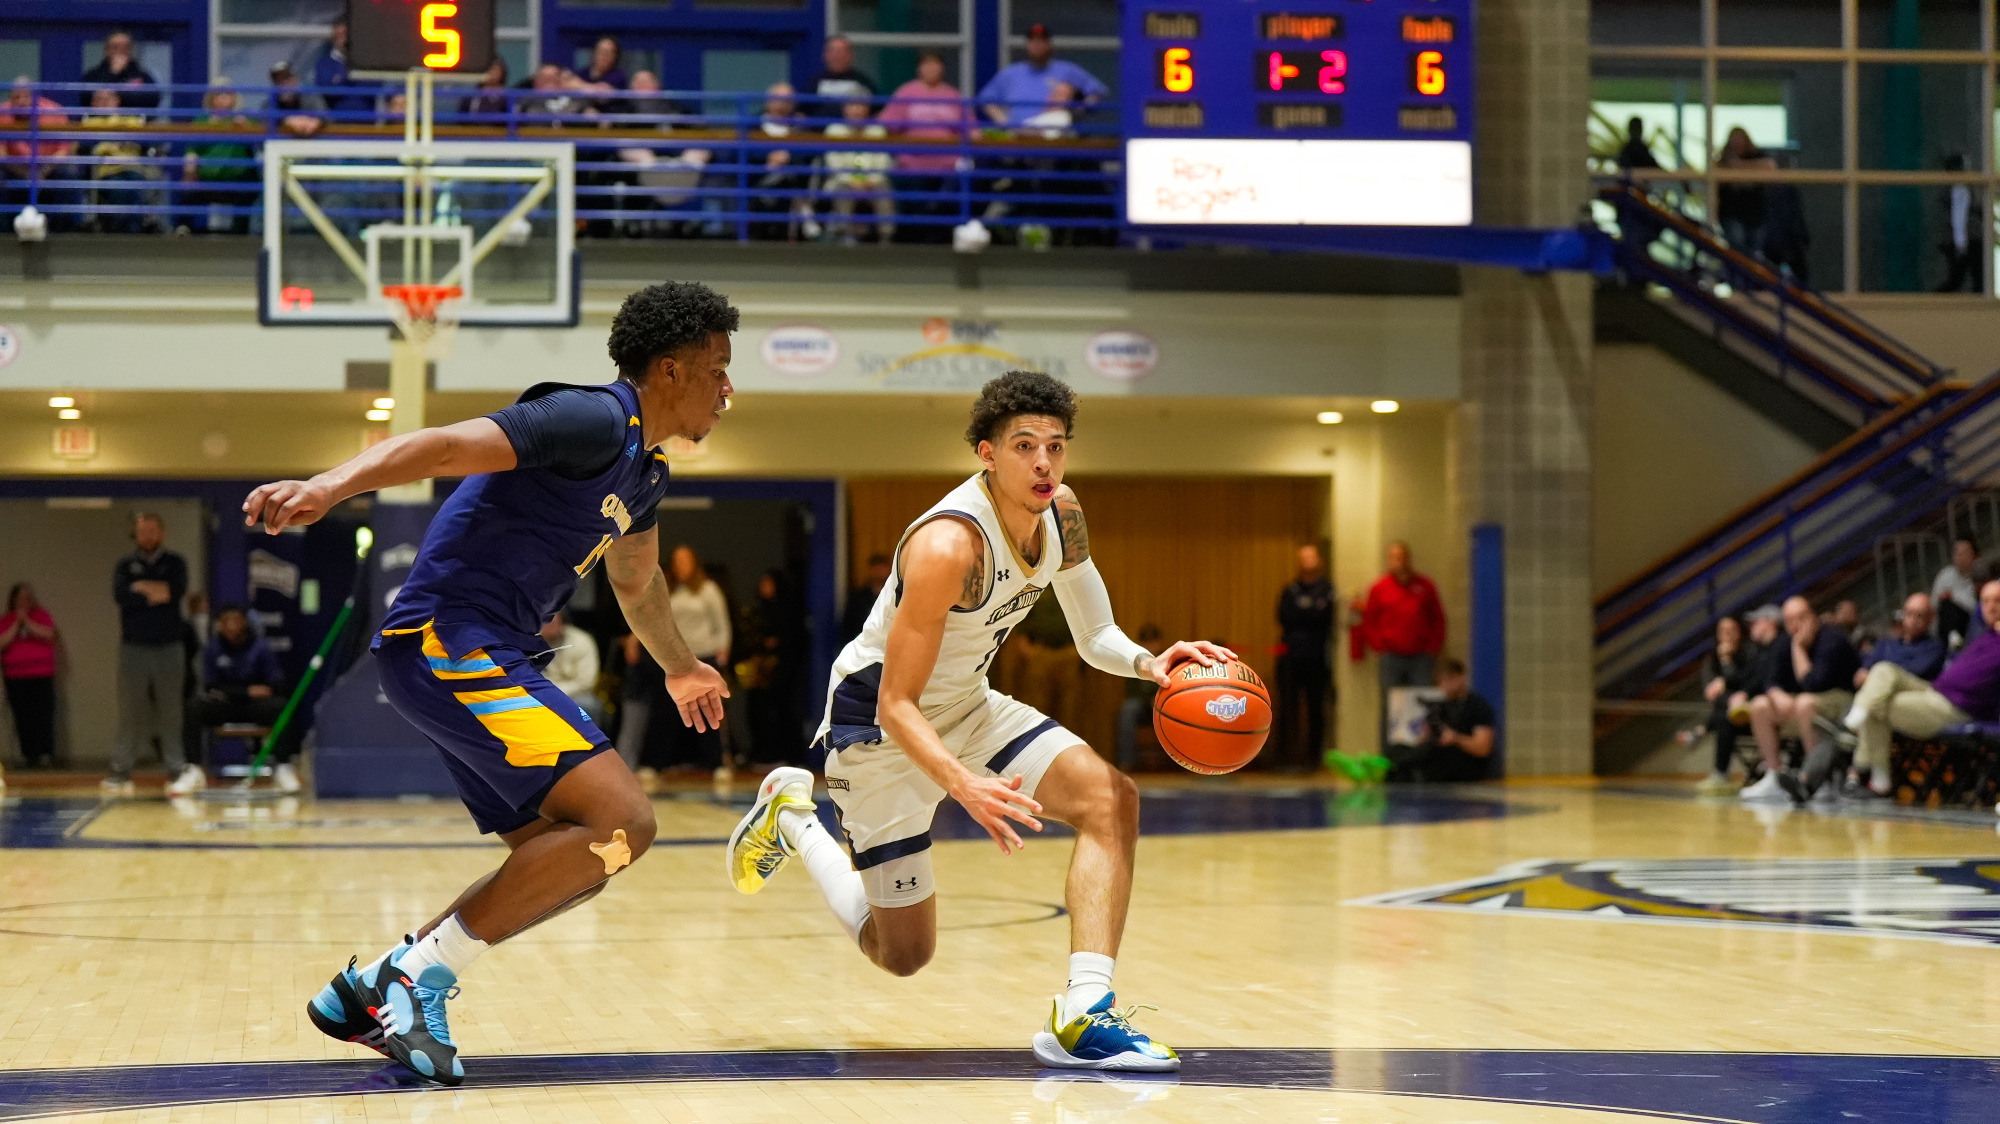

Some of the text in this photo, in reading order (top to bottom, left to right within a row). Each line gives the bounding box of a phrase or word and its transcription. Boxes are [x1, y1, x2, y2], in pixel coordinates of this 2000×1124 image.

[421, 4, 460, 68] 5
[1164, 48, 1193, 93] 6
[1417, 51, 1446, 95] 6
